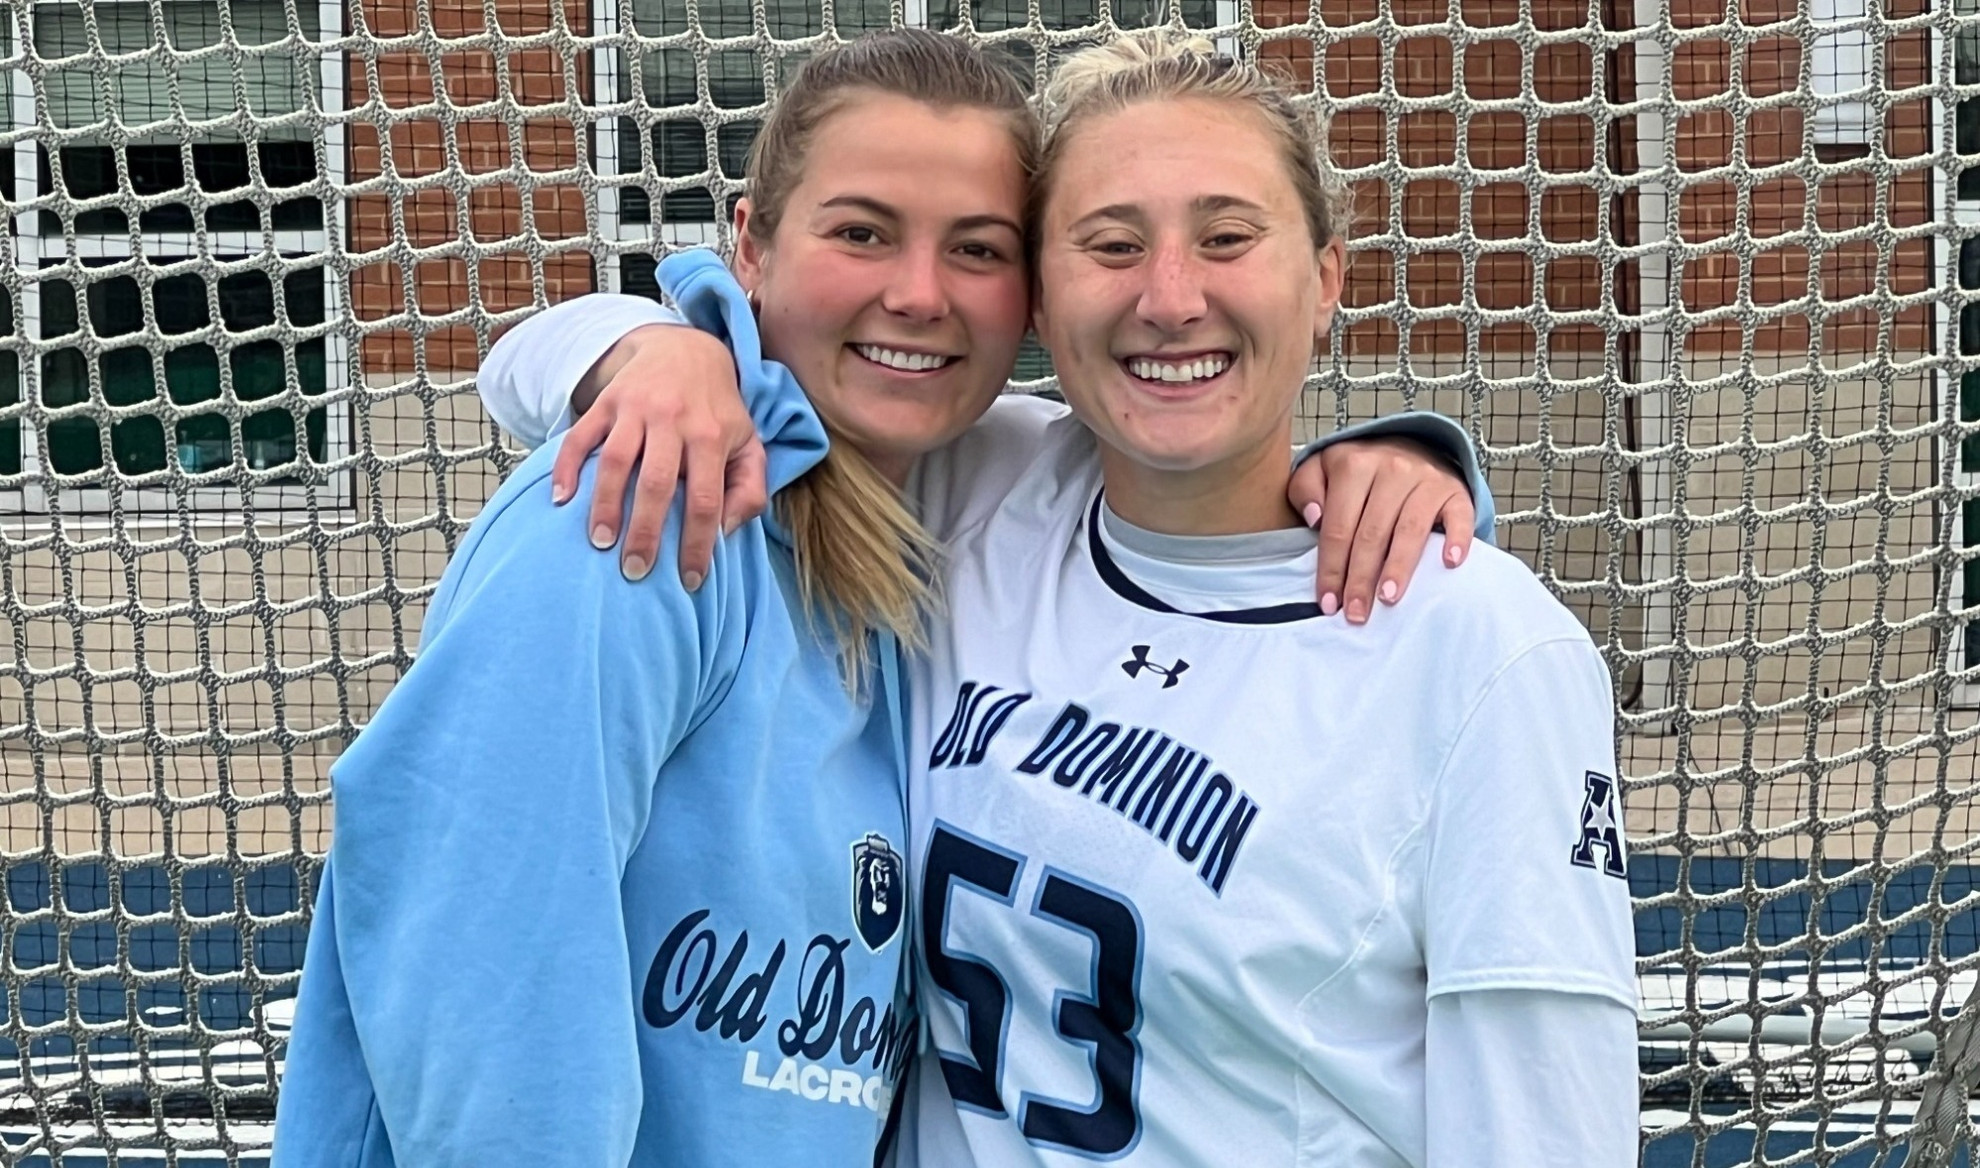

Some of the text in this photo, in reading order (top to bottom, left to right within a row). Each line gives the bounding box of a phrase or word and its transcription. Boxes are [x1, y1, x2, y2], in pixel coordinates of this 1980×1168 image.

[928, 680, 1260, 899] OLD DOMINION
[642, 908, 786, 1043] Old
[921, 818, 1146, 1162] 53
